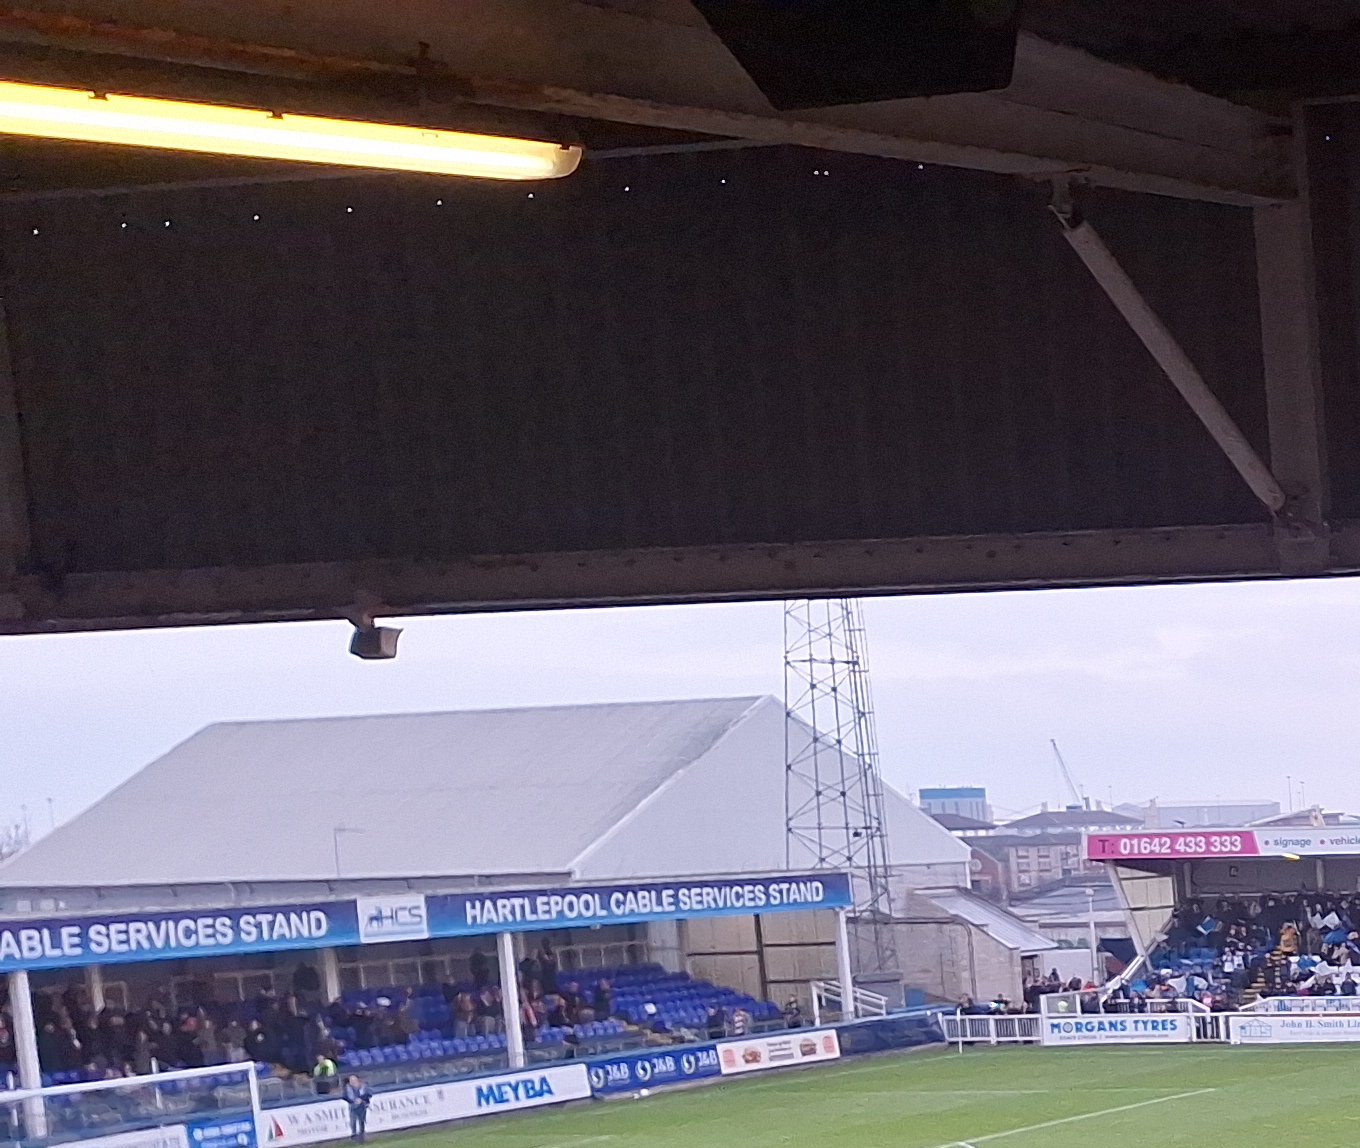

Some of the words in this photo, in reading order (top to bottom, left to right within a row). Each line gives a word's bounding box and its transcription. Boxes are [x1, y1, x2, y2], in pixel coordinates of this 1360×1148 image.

[1098, 839, 1116, 854] T:
[1120, 837, 1171, 854] 01642
[1175, 836, 1206, 853] 433
[1210, 835, 1242, 852] 333
[1273, 837, 1312, 848] signage
[465, 893, 608, 925] HARTLEPOOL
[609, 888, 674, 917] CABLE
[677, 884, 767, 912] SERVICES
[769, 881, 824, 905] STAND
[0, 926, 83, 961] ABLE
[87, 916, 233, 954] SERVICES
[239, 909, 328, 940] STAND
[1050, 1019, 1127, 1034] MORGANS
[1133, 1018, 1178, 1032] TYRES
[1280, 1019, 1303, 1028] John
[1317, 1019, 1344, 1028] Smith
[475, 1076, 554, 1108] MEYBA
